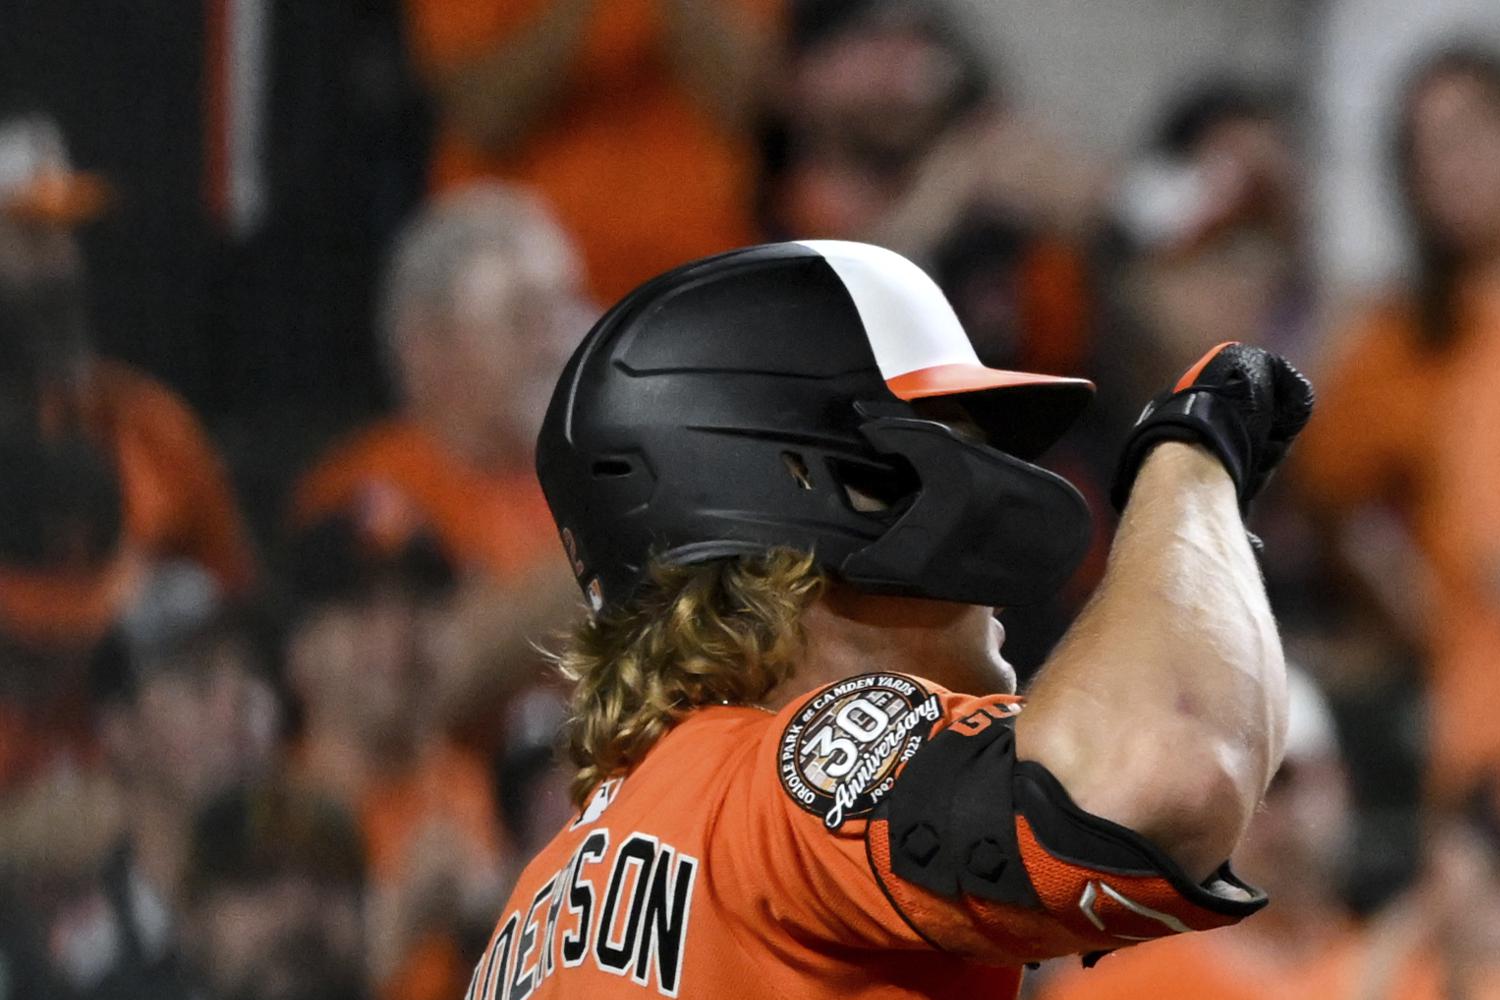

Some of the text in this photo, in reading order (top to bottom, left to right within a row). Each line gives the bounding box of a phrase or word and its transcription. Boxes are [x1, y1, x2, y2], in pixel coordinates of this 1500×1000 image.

[781, 675, 917, 805] ORIOLE PARK at CAMDEN YARDS
[800, 698, 890, 779] 30
[825, 695, 941, 828] Anniversary
